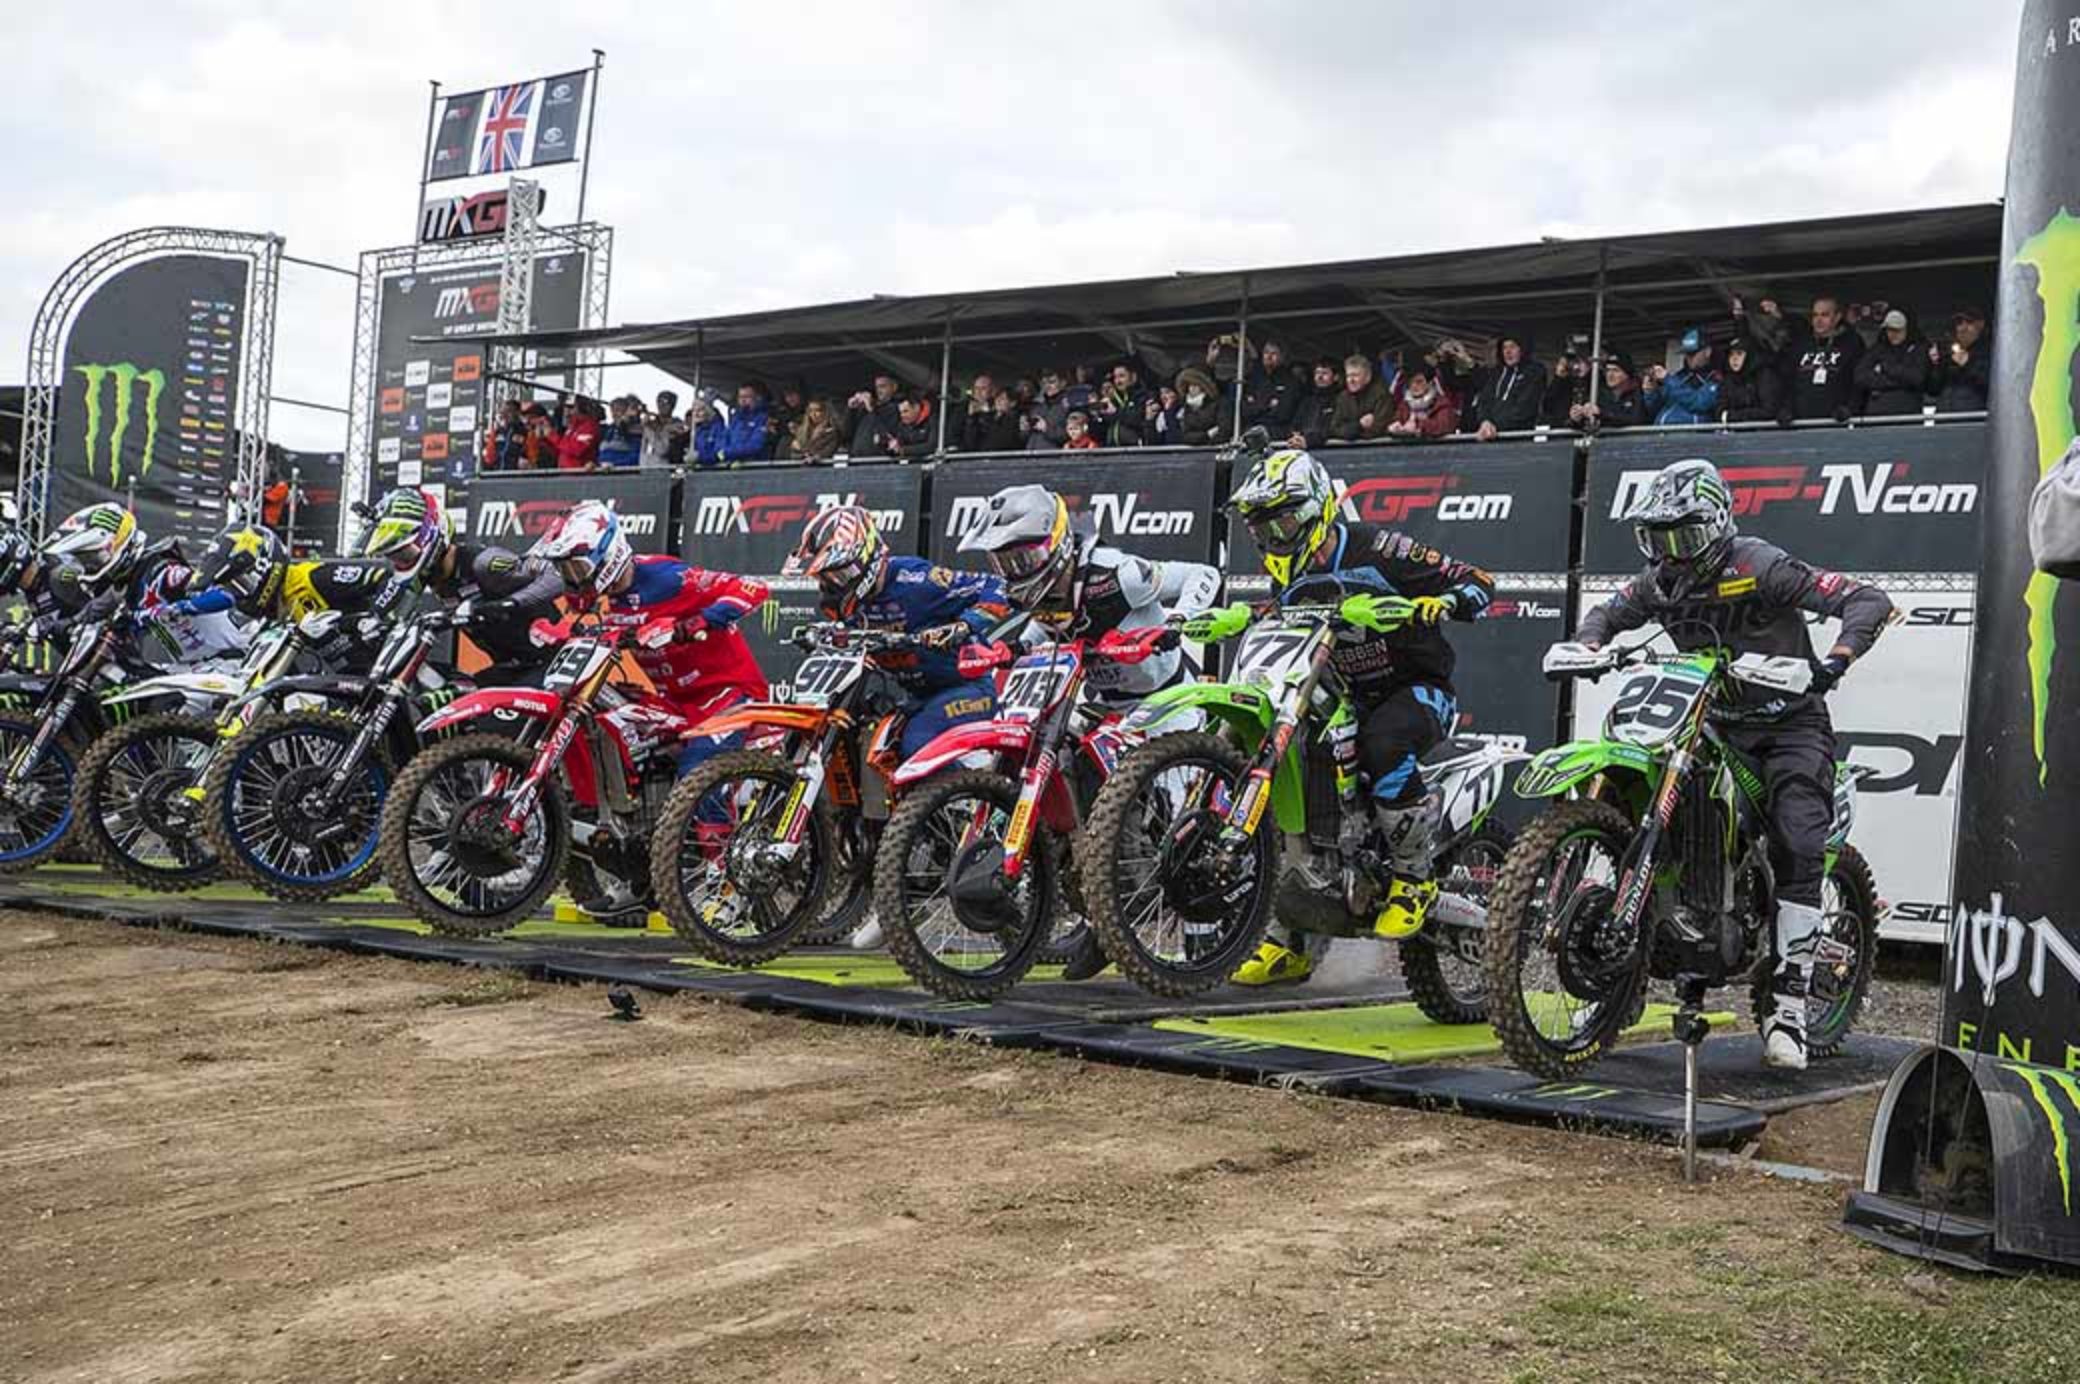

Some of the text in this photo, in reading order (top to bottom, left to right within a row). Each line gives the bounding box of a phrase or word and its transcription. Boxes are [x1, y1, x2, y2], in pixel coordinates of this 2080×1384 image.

[419, 188, 546, 243] MXG
[434, 283, 501, 318] MXG
[1240, 634, 1306, 671] 77
[1612, 675, 1702, 729] 25
